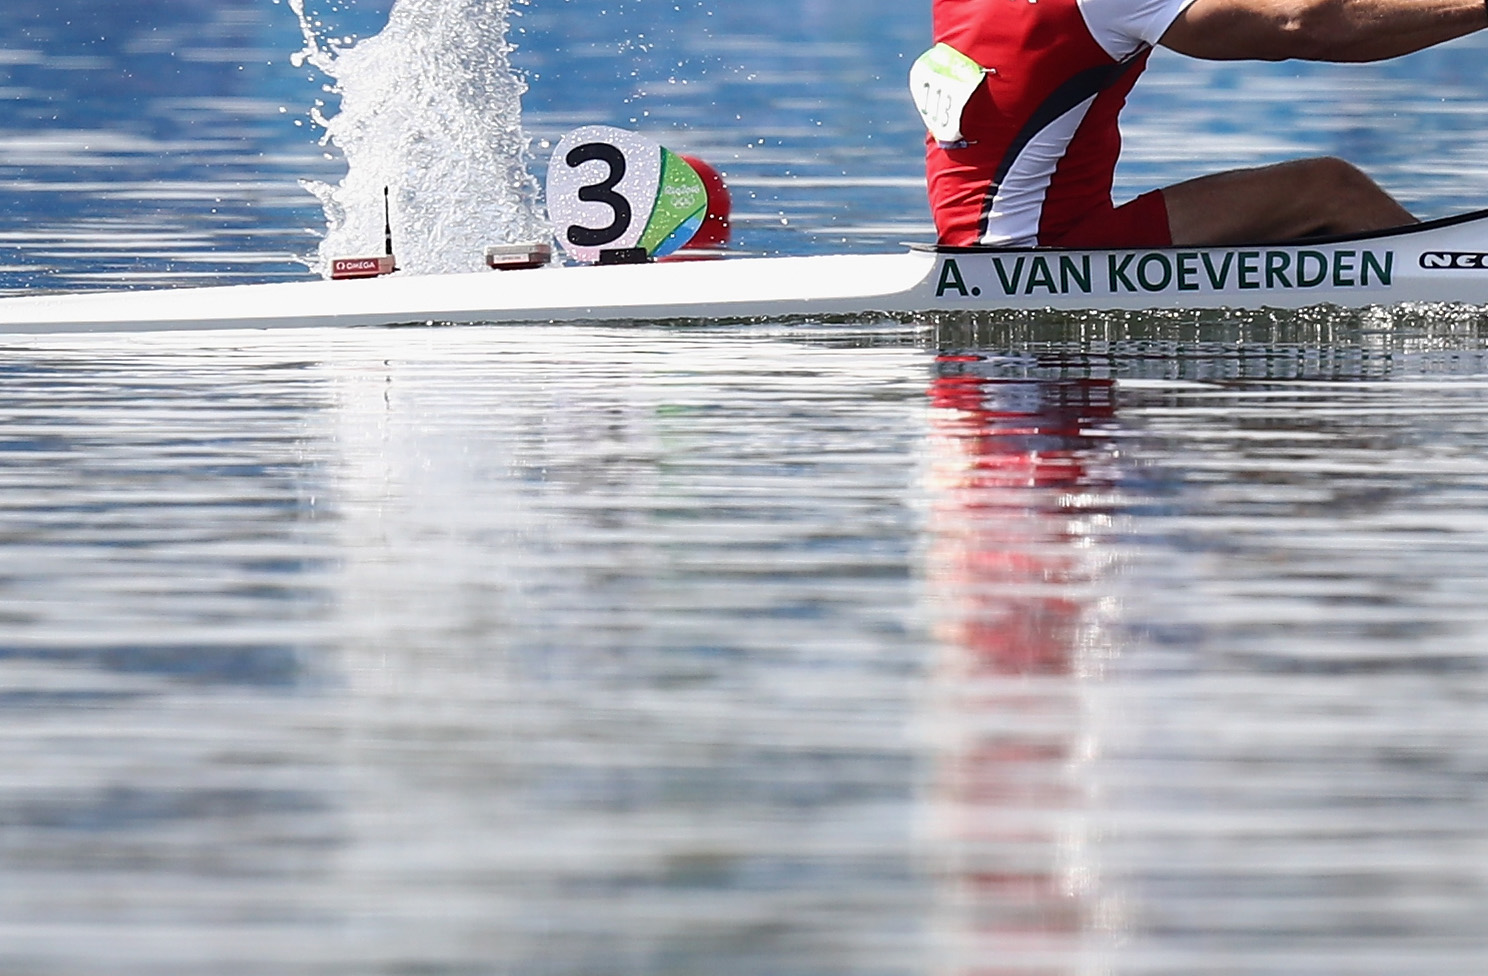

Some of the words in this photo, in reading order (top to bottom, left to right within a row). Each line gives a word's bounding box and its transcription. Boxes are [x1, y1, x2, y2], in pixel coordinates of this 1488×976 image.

[566, 142, 631, 246] 3
[935, 258, 981, 297] A.
[992, 255, 1092, 296] VAN
[1108, 250, 1395, 293] KOEVERDEN
